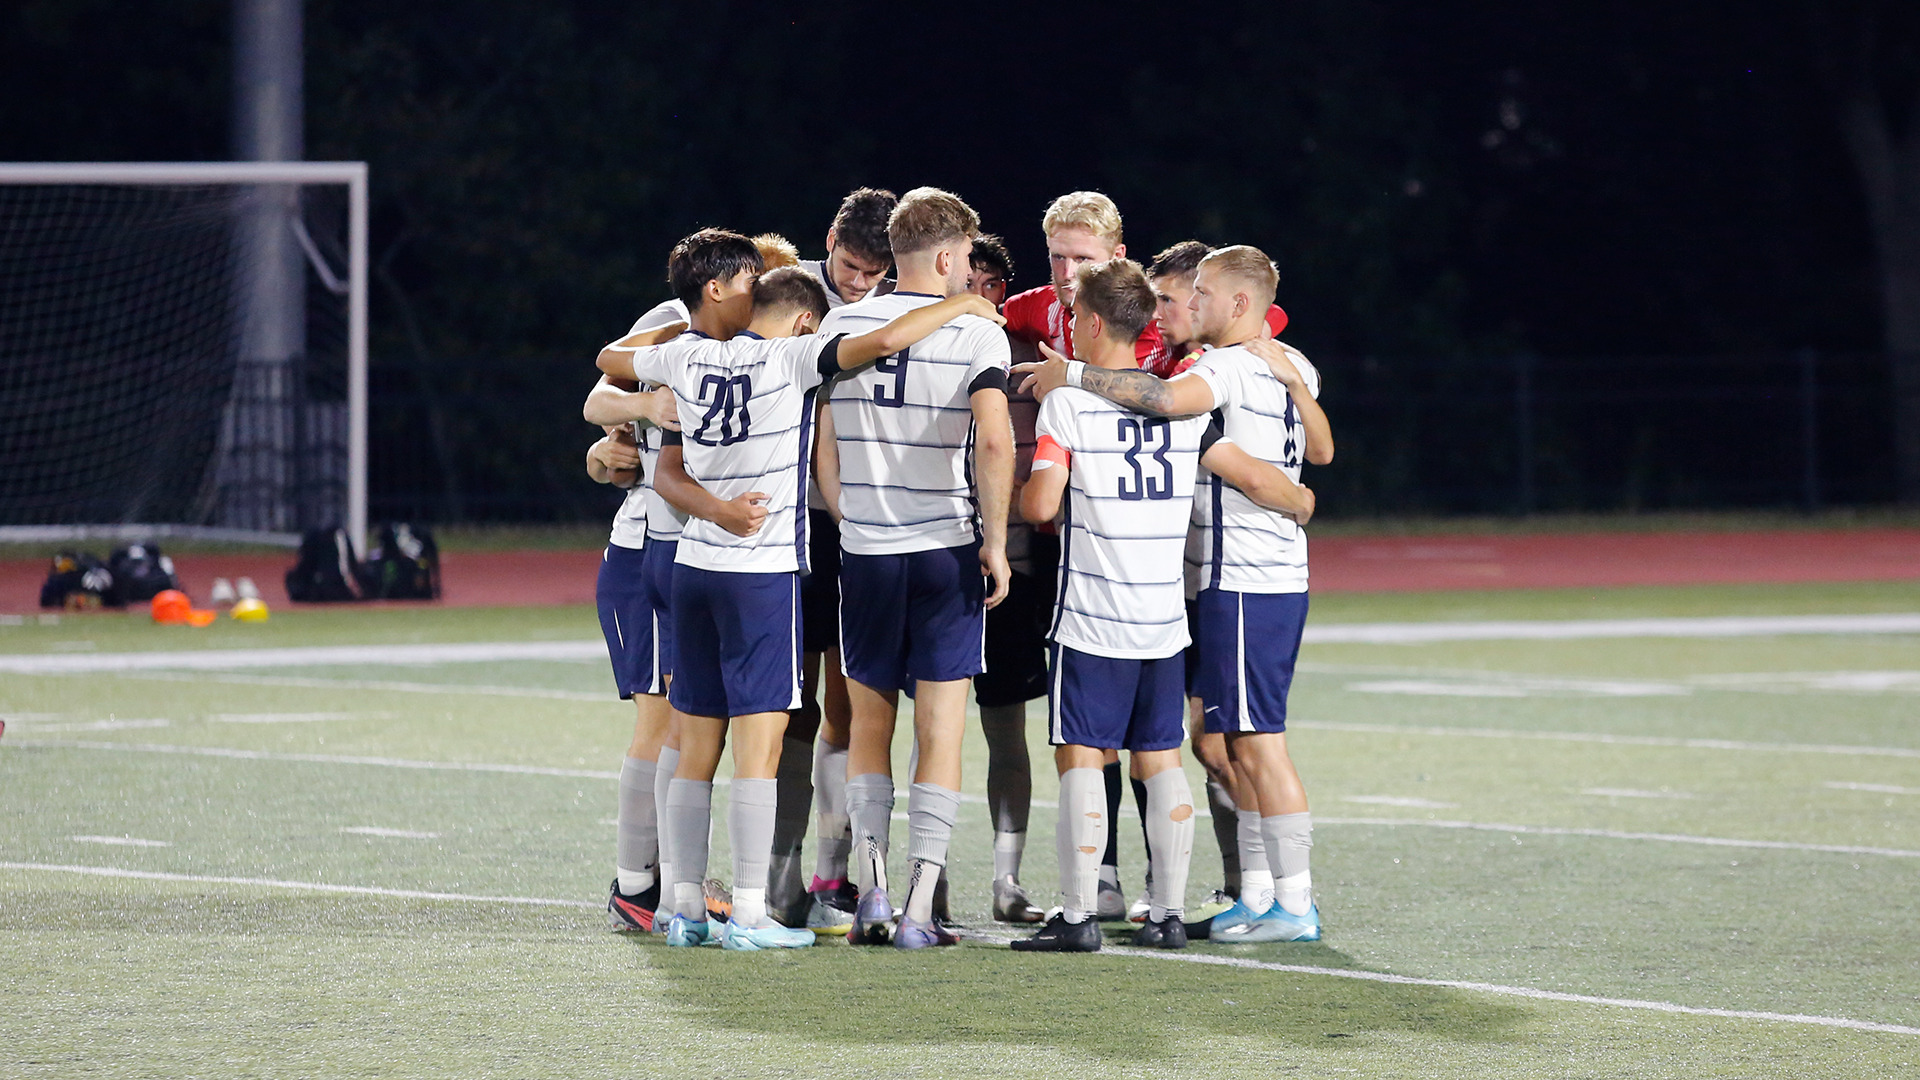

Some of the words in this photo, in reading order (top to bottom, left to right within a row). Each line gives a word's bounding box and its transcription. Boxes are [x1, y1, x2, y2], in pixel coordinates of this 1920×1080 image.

[692, 374, 752, 447] 20
[874, 346, 910, 408] 9
[1117, 417, 1173, 501] 33
